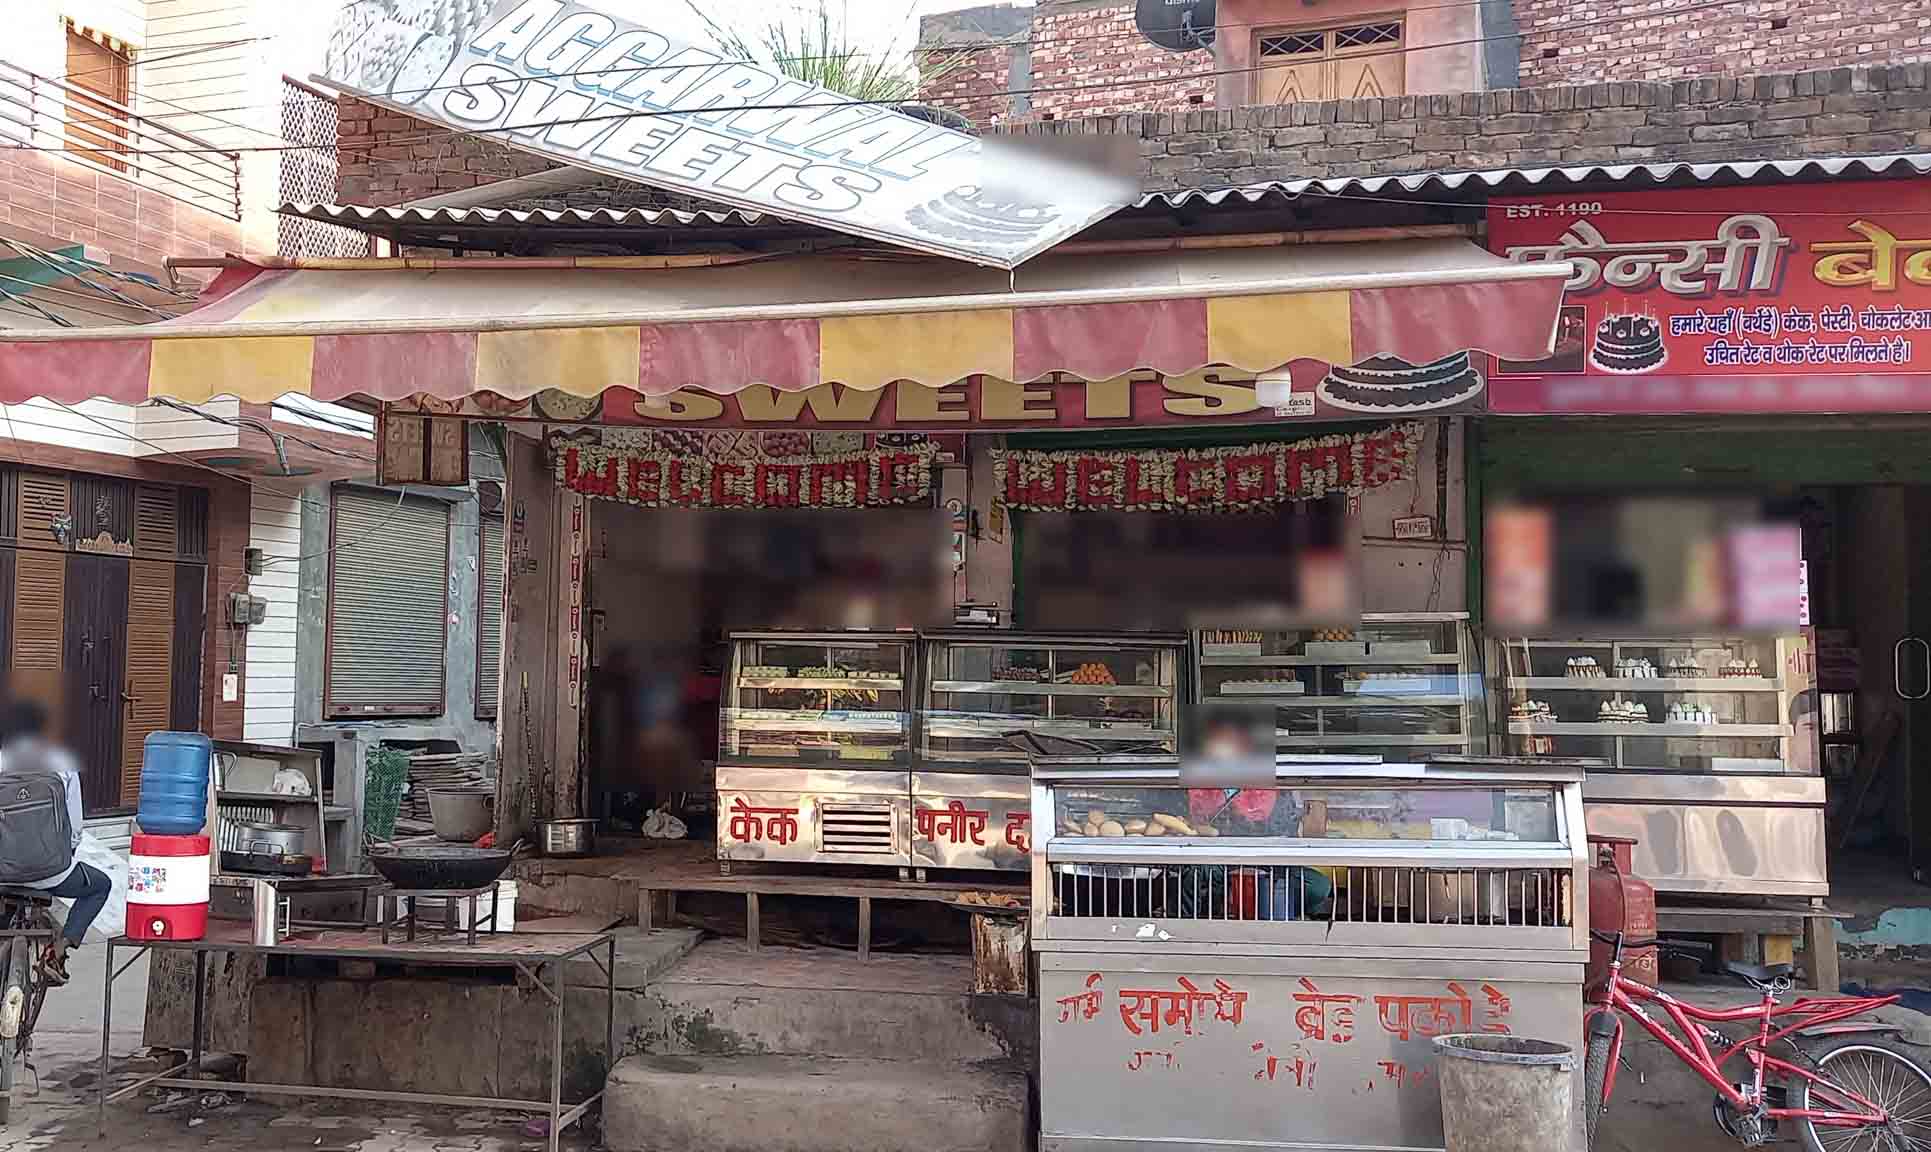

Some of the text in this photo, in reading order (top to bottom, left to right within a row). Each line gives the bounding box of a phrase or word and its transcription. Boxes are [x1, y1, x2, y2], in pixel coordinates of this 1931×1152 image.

[469, 0, 973, 180] AGGARWAL
[443, 62, 883, 212] SWEETS
[1506, 204, 1549, 218] EST.
[1671, 308, 1703, 335] हमारे
[1704, 339, 1741, 365] उचित
[1741, 339, 1762, 364] रेट
[1776, 338, 1806, 364] थोक
[1806, 338, 1827, 364] रेट
[1827, 345, 1848, 364] पर
[1848, 336, 1890, 363] मिलते
[730, 797, 799, 845] केक
[914, 800, 990, 845] पनीर
